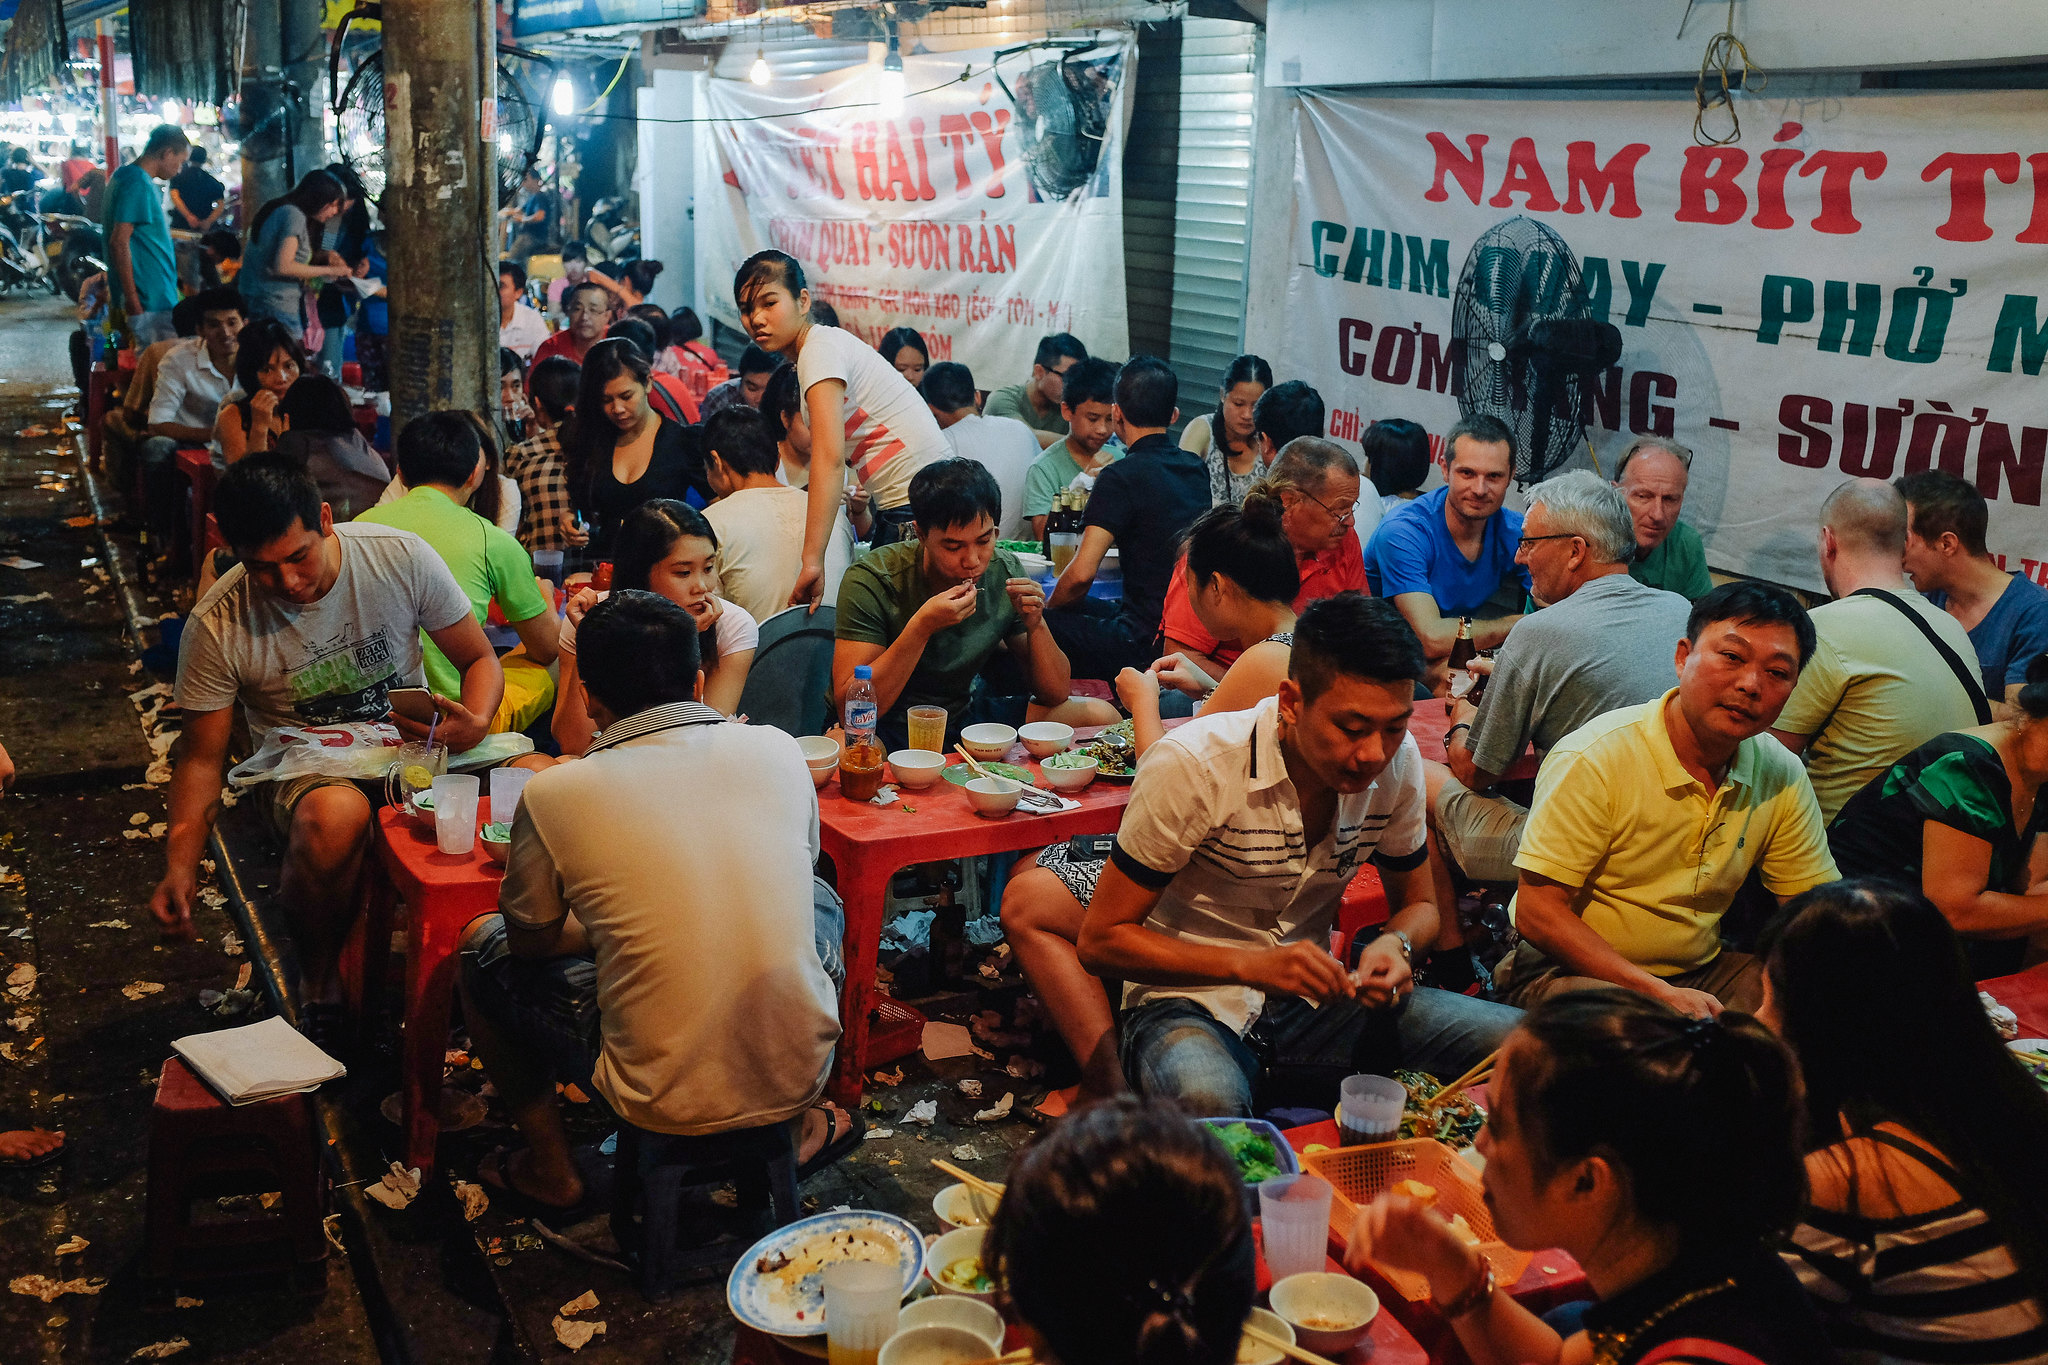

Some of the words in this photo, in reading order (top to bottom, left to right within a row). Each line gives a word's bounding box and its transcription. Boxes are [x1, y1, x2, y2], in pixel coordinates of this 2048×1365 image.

[1424, 131, 1651, 218] NAM
[1674, 121, 1888, 234] BÍT
[817, 220, 871, 273] QUAY
[1311, 220, 1450, 299] CHIM
[1756, 266, 1968, 364] PHỞ
[1338, 318, 1467, 397] CƠM
[1778, 395, 2048, 507] SƯỜN
